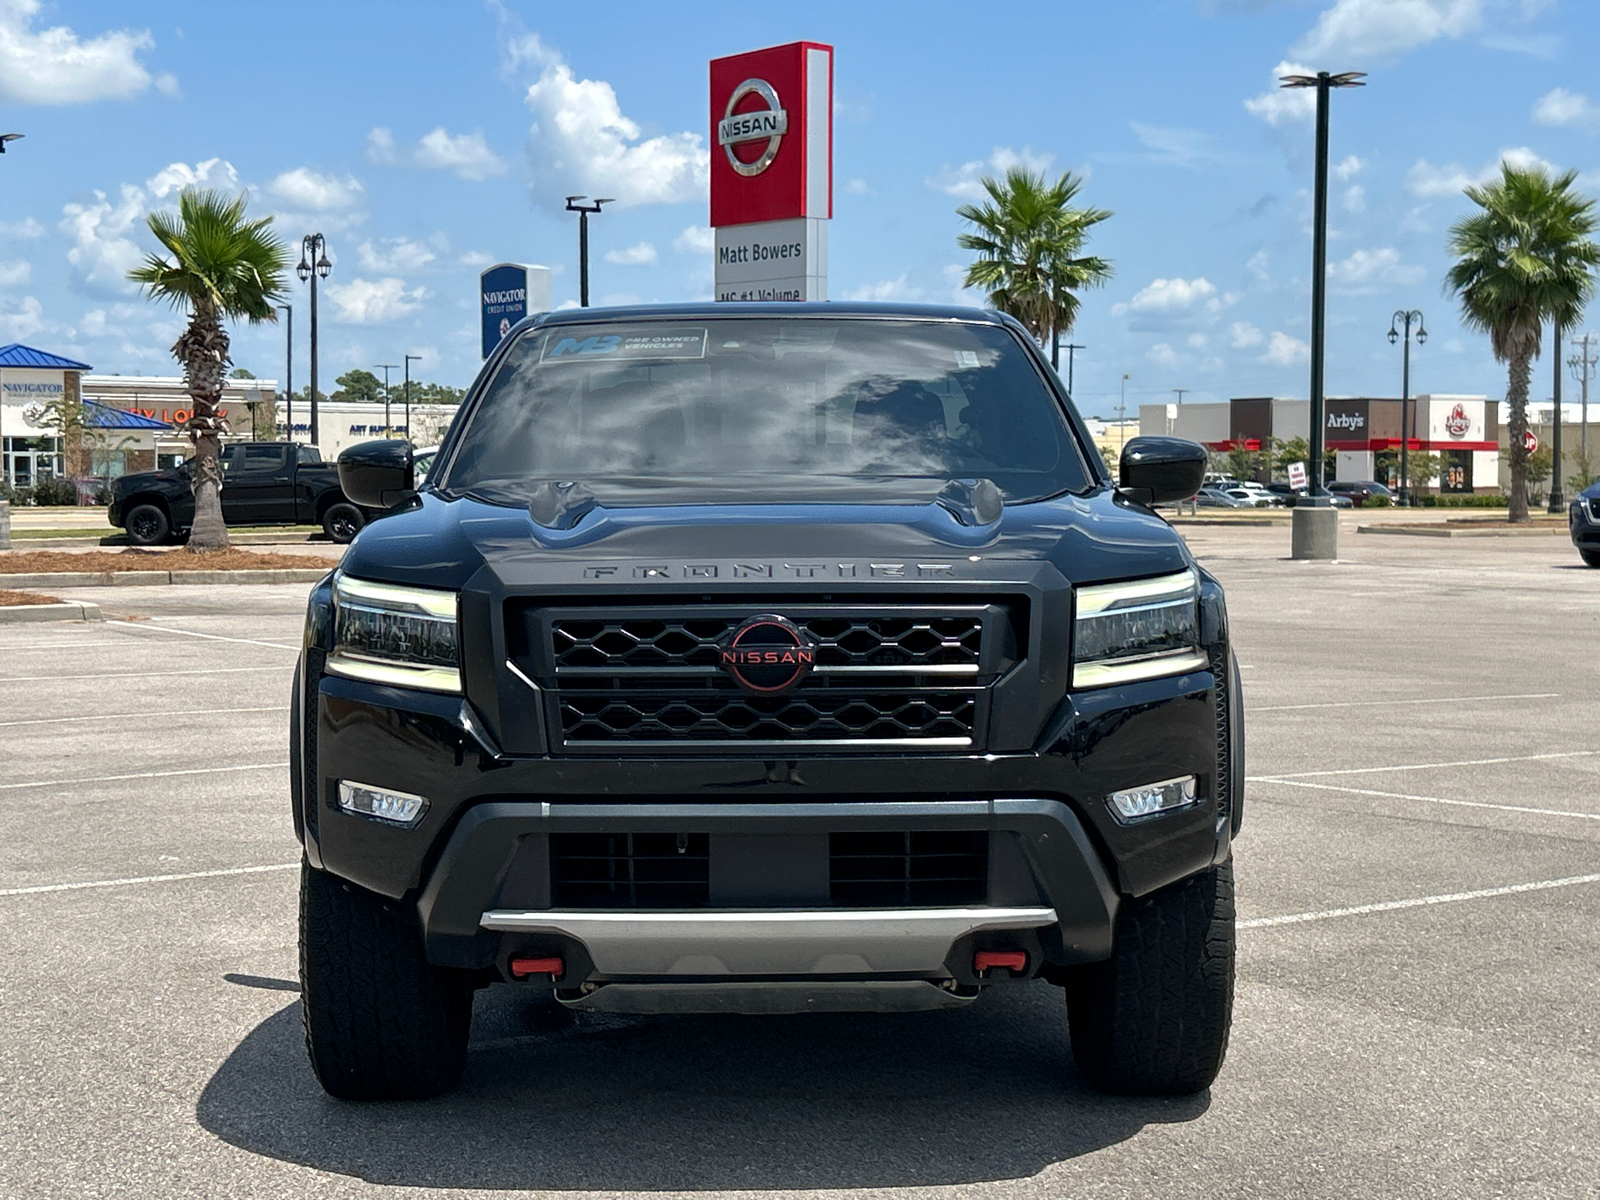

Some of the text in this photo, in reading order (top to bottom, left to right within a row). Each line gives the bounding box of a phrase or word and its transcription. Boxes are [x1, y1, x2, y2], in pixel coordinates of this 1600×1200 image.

[721, 115, 777, 140] NISSAN
[719, 242, 802, 264] Matt Bowers
[483, 288, 526, 305] NAVIGATOR
[487, 303, 523, 314] CREDIT UNION
[3, 383, 64, 393] NAVIGATOR
[349, 424, 368, 433] ART
[1327, 412, 1364, 431] Arby's
[583, 562, 956, 580] FRONTIER
[722, 651, 813, 664] NISSAN
